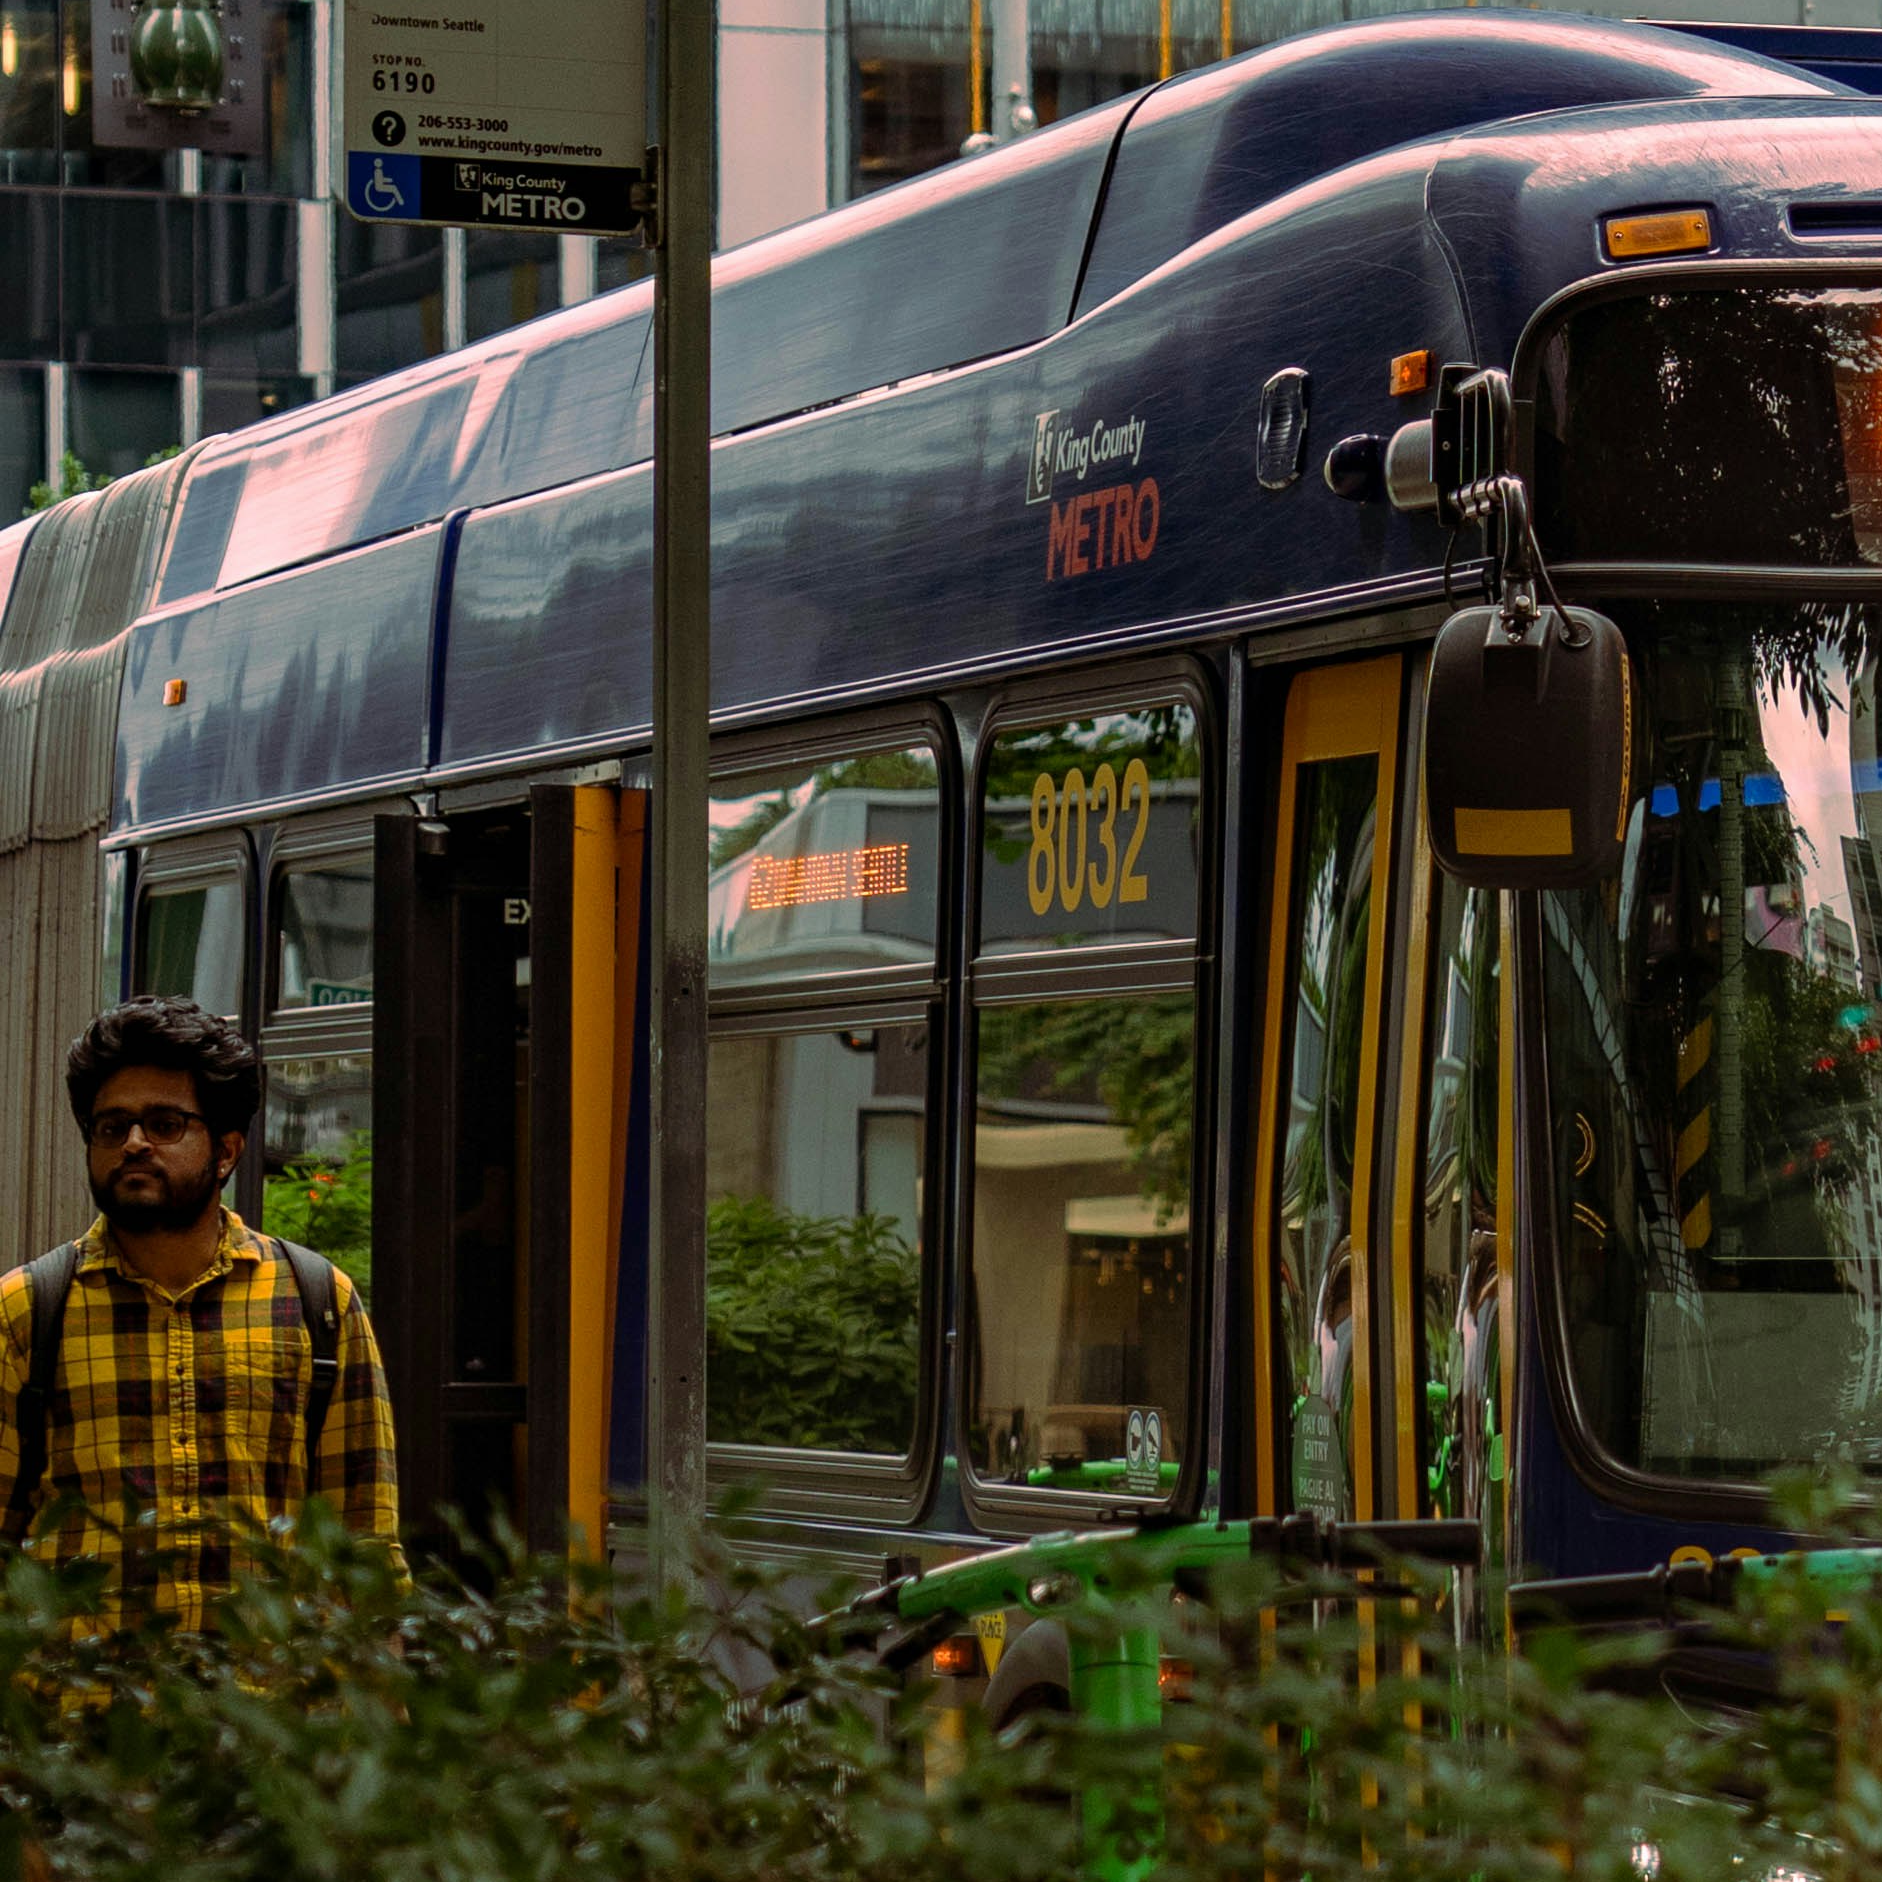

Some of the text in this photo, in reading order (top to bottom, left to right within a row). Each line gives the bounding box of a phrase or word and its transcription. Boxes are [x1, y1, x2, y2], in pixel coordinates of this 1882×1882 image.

[442, 18, 485, 33] Seattle
[372, 54, 426, 68] STOP NO.
[372, 69, 436, 95] 6190
[417, 115, 509, 133] 206-553-3000
[418, 134, 603, 157] www.kingcounty.gov/metro
[482, 171, 567, 194] King County
[481, 192, 587, 221] METRO
[1055, 415, 1146, 481] King County
[1046, 475, 1160, 583] METRO
[1027, 757, 1150, 916] 8032
[1303, 1438, 1329, 1462] ENTRY
